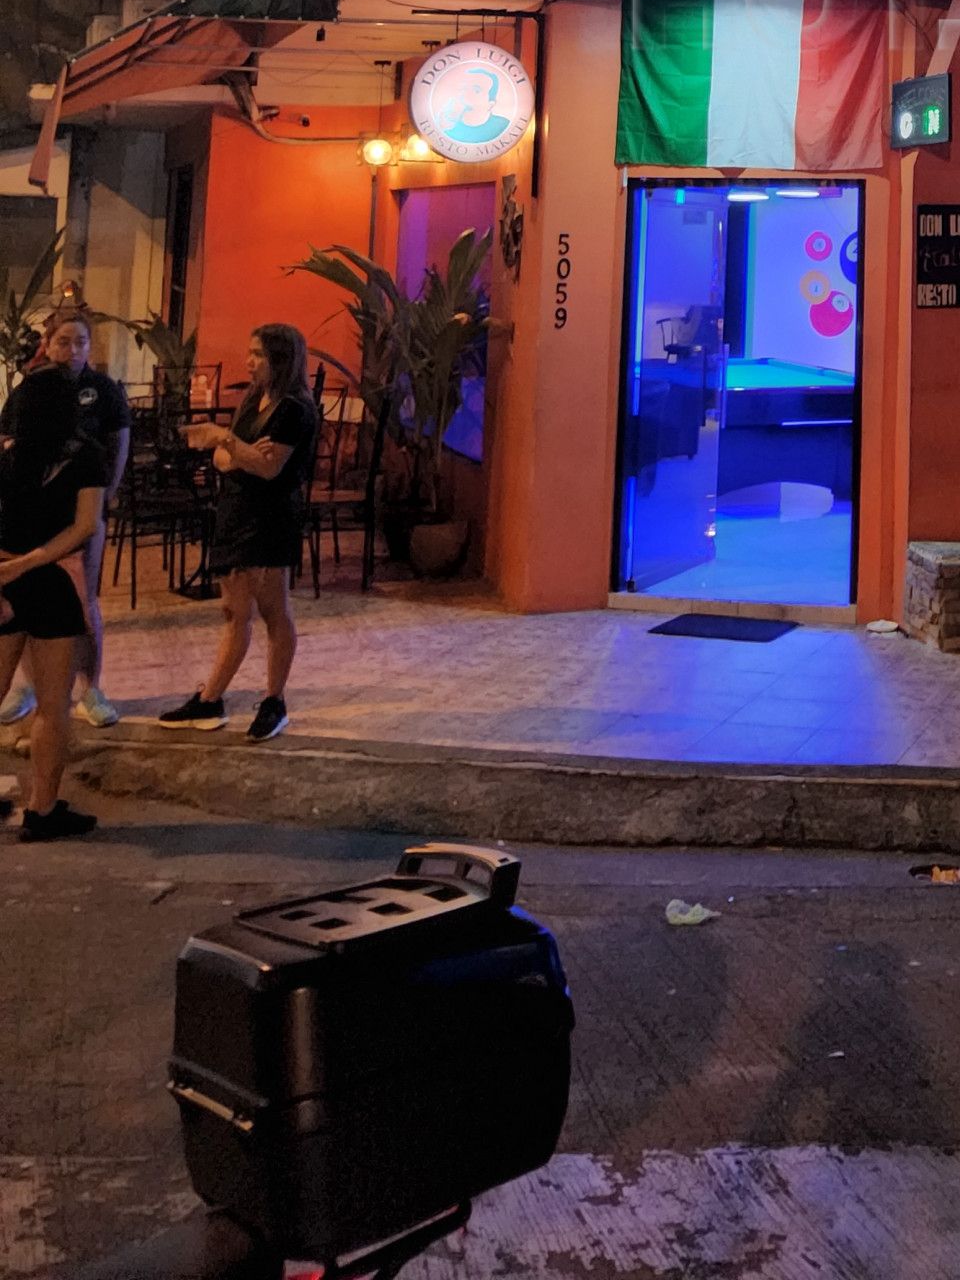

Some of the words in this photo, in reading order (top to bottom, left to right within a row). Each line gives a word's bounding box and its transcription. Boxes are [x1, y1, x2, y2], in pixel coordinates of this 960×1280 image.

[421, 50, 461, 86] DON
[476, 47, 526, 84] LUIGI
[420, 120, 468, 156] RESTO
[475, 116, 528, 157] MAKATI
[919, 214, 943, 237] DON
[553, 233, 571, 329] 5059
[917, 283, 957, 307] RESTO
